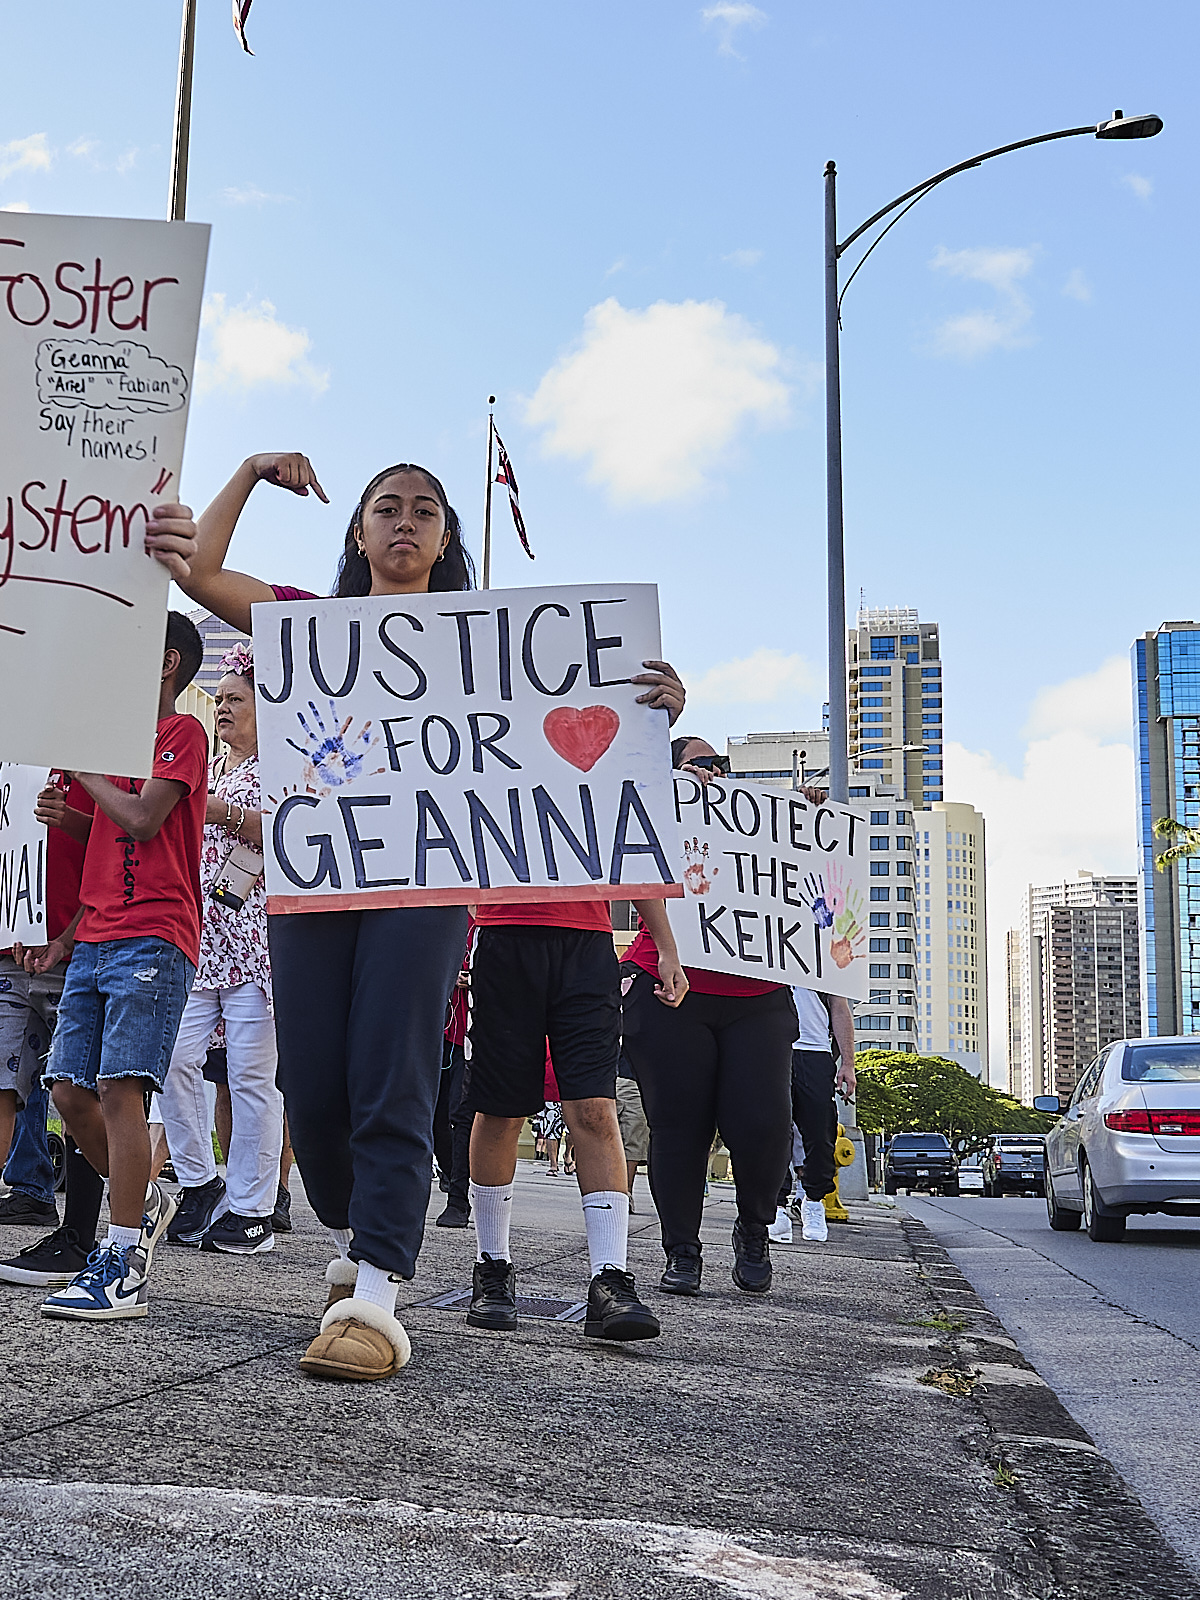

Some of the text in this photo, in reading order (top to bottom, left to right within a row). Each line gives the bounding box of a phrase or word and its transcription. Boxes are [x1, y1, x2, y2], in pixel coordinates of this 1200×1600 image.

[39, 407, 134, 446] Say their
[82, 436, 157, 462] names!
[257, 598, 632, 704] JUSTICE
[381, 713, 522, 775] FOR
[272, 780, 675, 889] GEANNA
[673, 778, 866, 857] PROTECT
[722, 851, 802, 908] THE
[698, 902, 823, 979] KEIKI
[243, 1224, 265, 1239] HOKA
